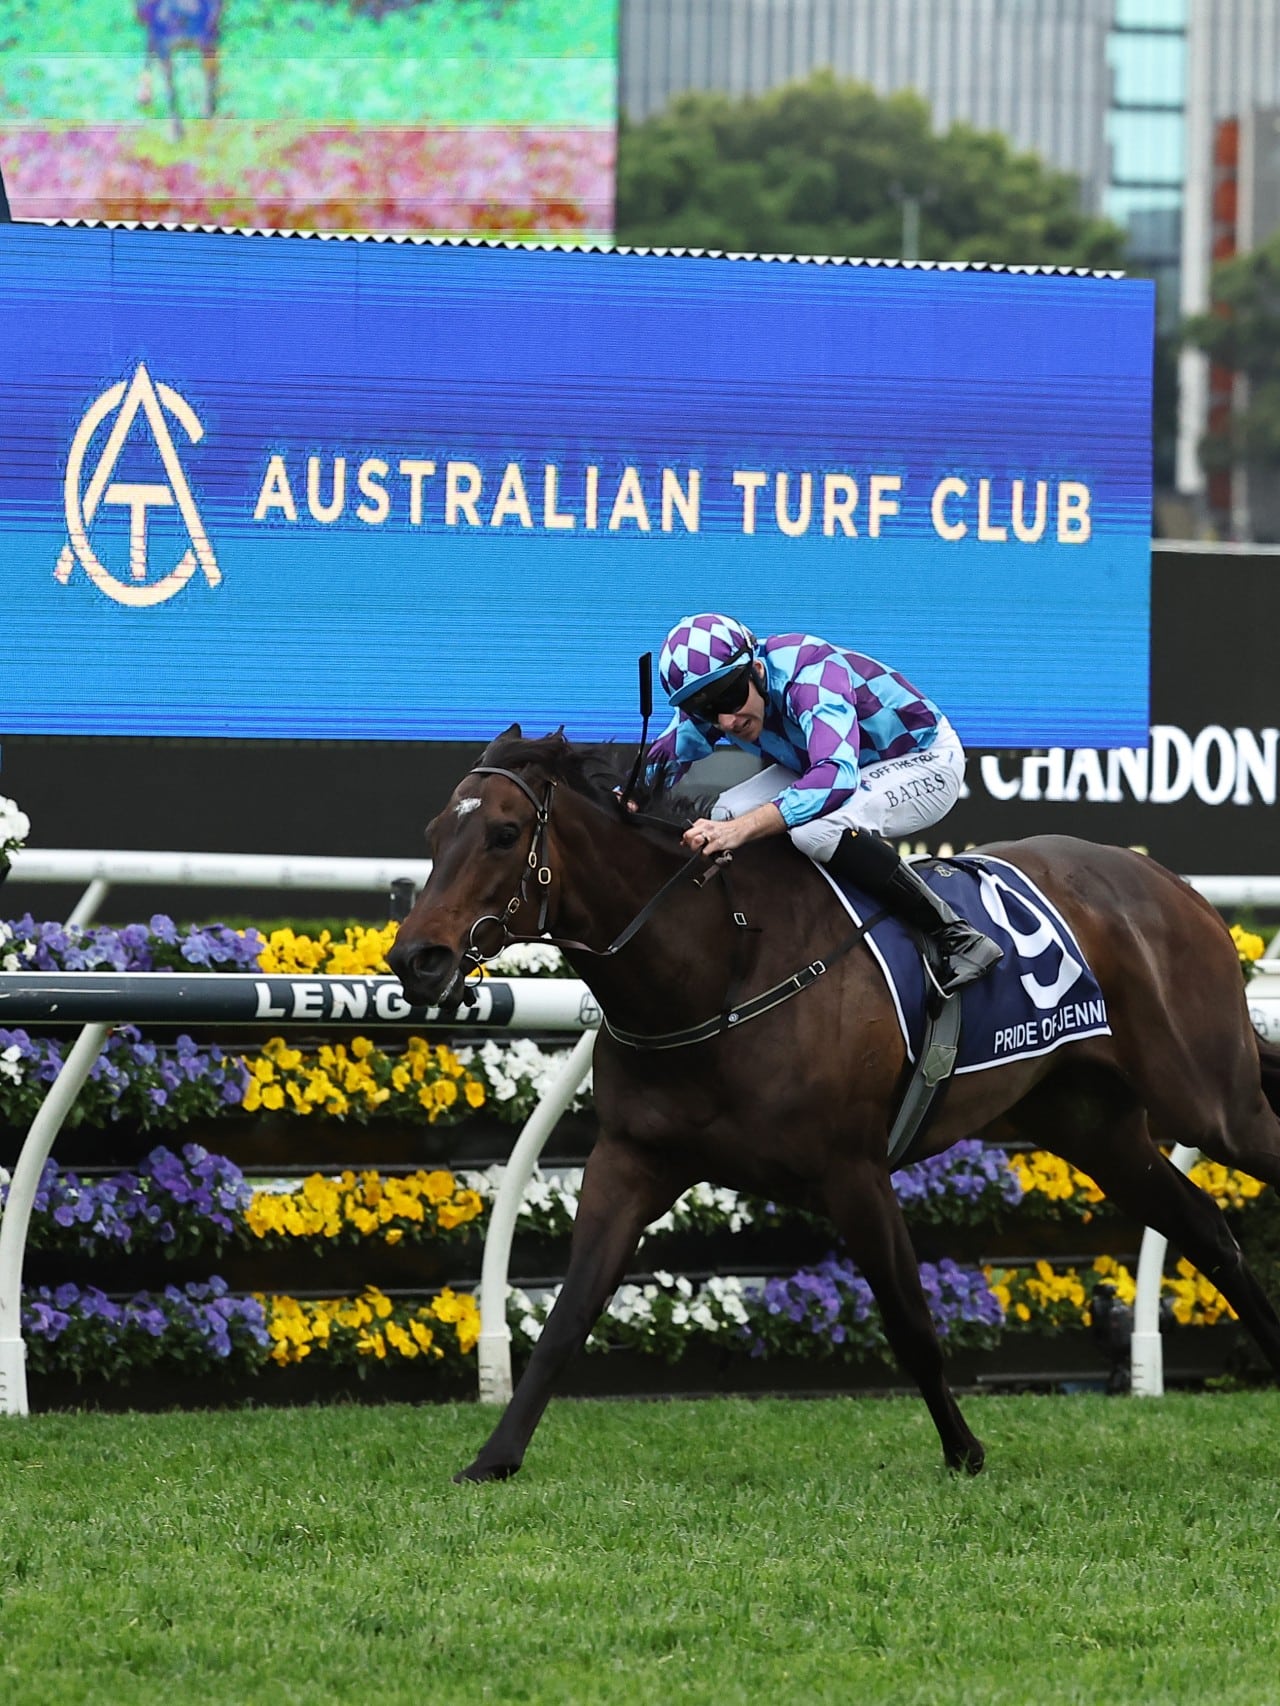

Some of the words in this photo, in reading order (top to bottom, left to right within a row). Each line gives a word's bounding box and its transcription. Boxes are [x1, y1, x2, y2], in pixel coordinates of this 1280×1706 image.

[253, 455, 699, 532] AUSTRALIAN
[733, 471, 901, 538] TURF
[931, 477, 1092, 543] CLUB
[869, 766, 890, 779] OFF
[884, 773, 946, 808] BATES
[978, 868, 1083, 1010] 9
[993, 1021, 1038, 1054] PRIDE
[1041, 1012, 1058, 1041] OF
